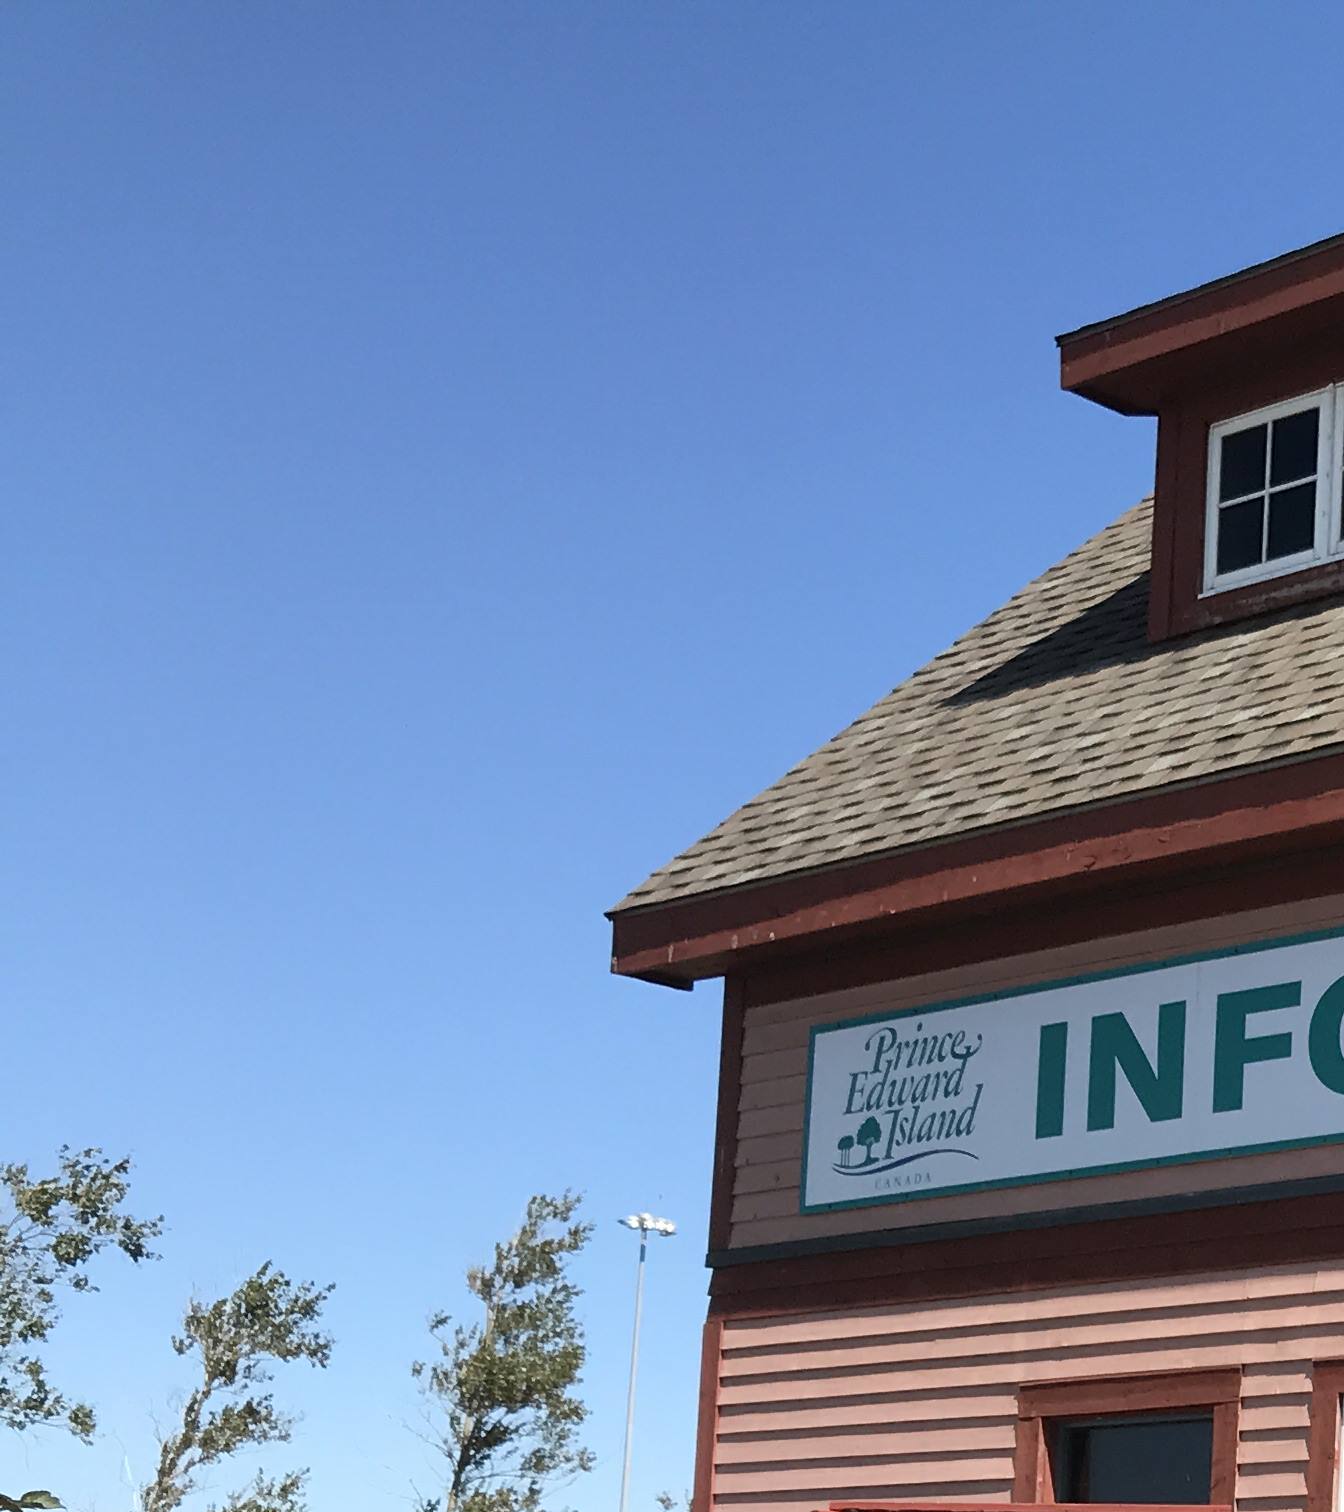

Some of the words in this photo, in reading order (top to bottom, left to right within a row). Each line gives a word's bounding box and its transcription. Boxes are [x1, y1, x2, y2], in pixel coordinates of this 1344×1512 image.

[864, 1021, 983, 1075] Prince
[842, 1056, 969, 1115] Edward
[881, 1082, 984, 1160] Island
[873, 1171, 933, 1191] CANADA
